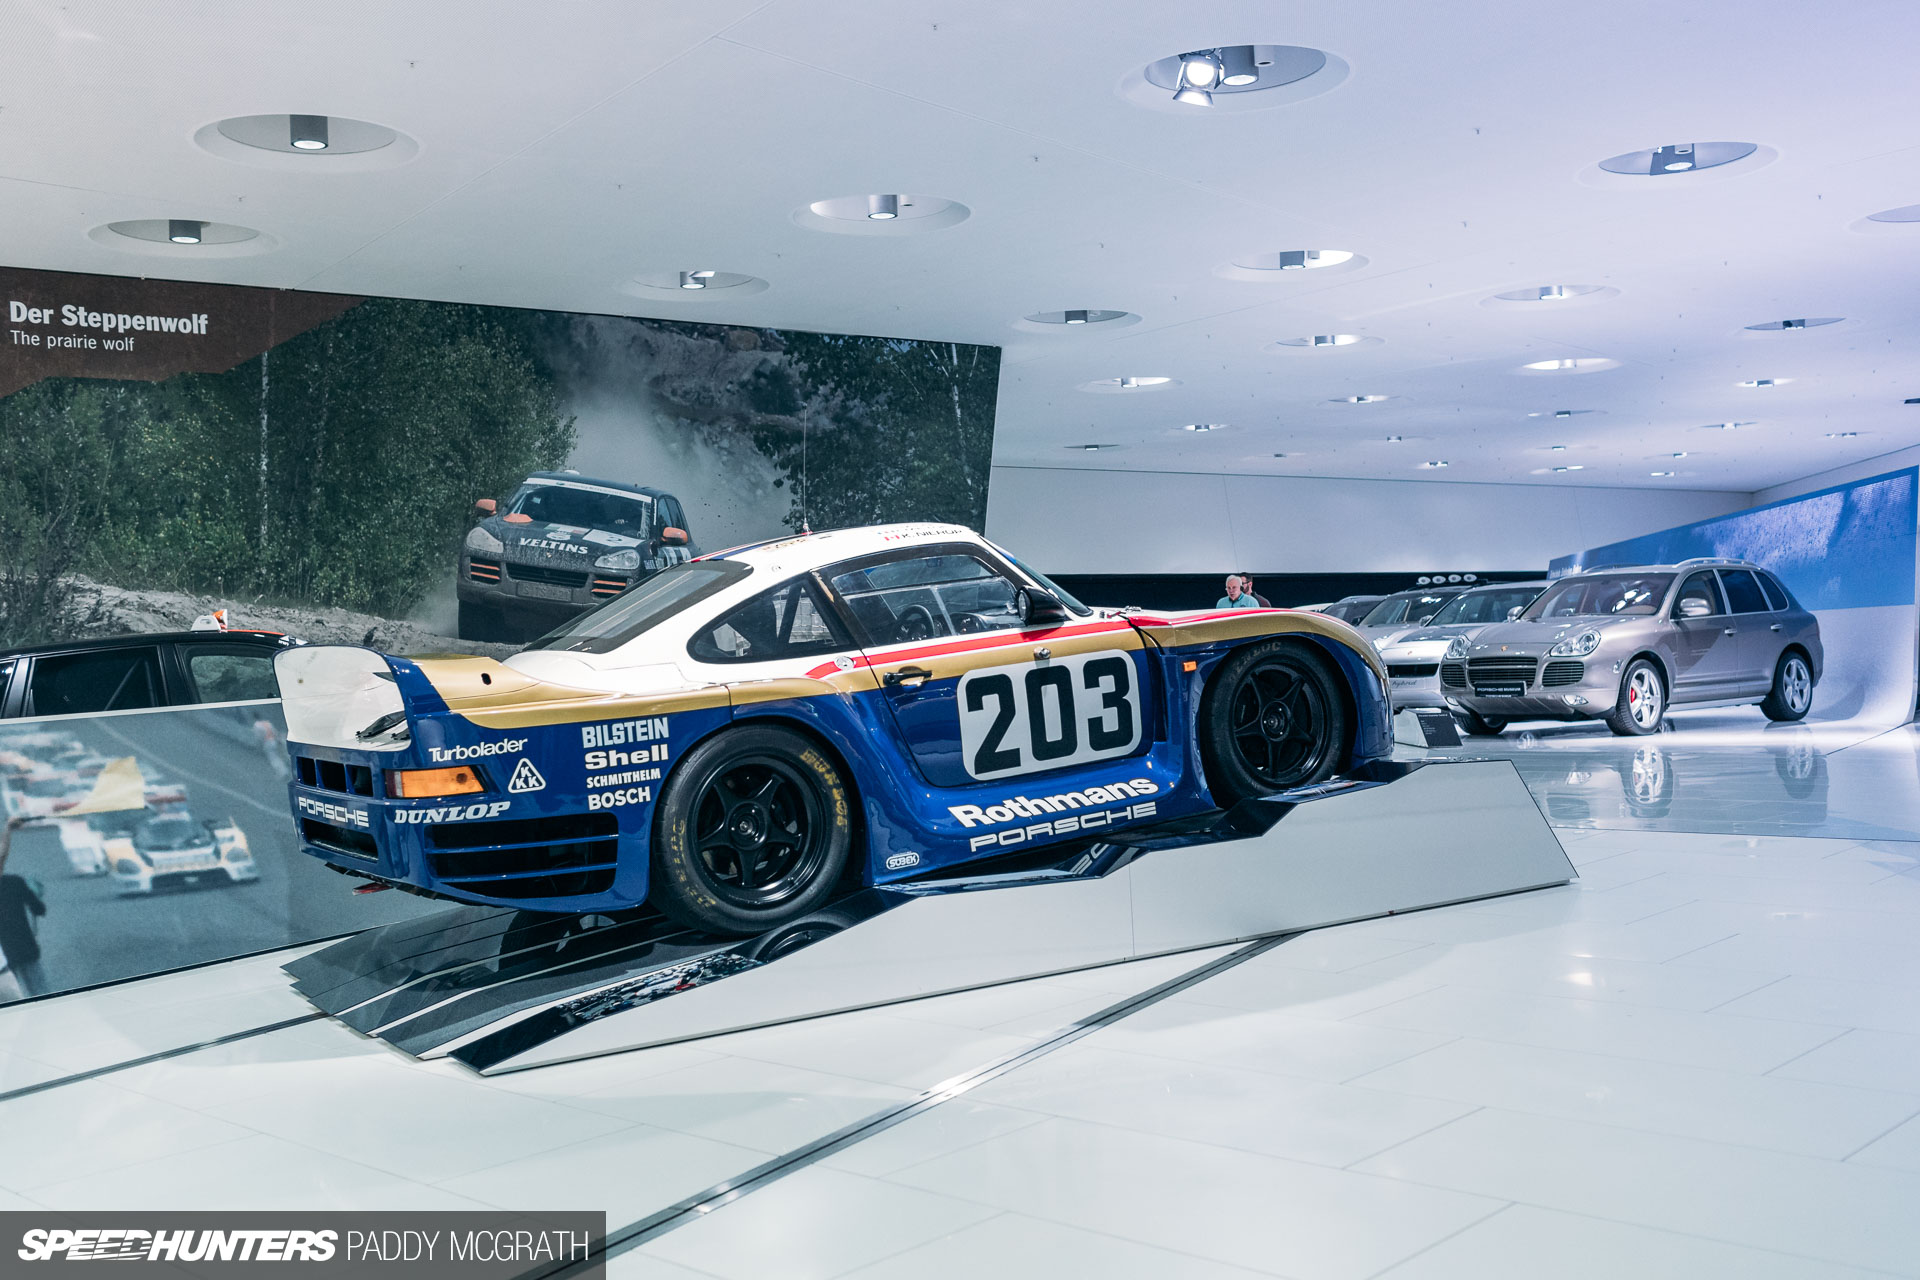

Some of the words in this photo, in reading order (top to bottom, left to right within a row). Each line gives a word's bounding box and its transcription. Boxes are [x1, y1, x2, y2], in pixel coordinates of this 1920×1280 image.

[10, 301, 54, 324] Der
[61, 304, 209, 335] Steppenwolf
[10, 330, 40, 345] The
[47, 333, 97, 349] prairie
[103, 337, 135, 351] wolf
[519, 537, 589, 554] VELTINS
[965, 656, 1134, 775] 203
[581, 717, 669, 748] BILSTEIN
[429, 738, 528, 763] Turbolader
[584, 743, 669, 770] Shell
[586, 767, 662, 789] SCHMITTHELM
[299, 796, 369, 828] PORSCHE
[588, 786, 651, 811] BOSCH
[947, 778, 1159, 829] Rothmans
[394, 800, 511, 825] DUNLOP
[970, 801, 1157, 852] PORSCHE
